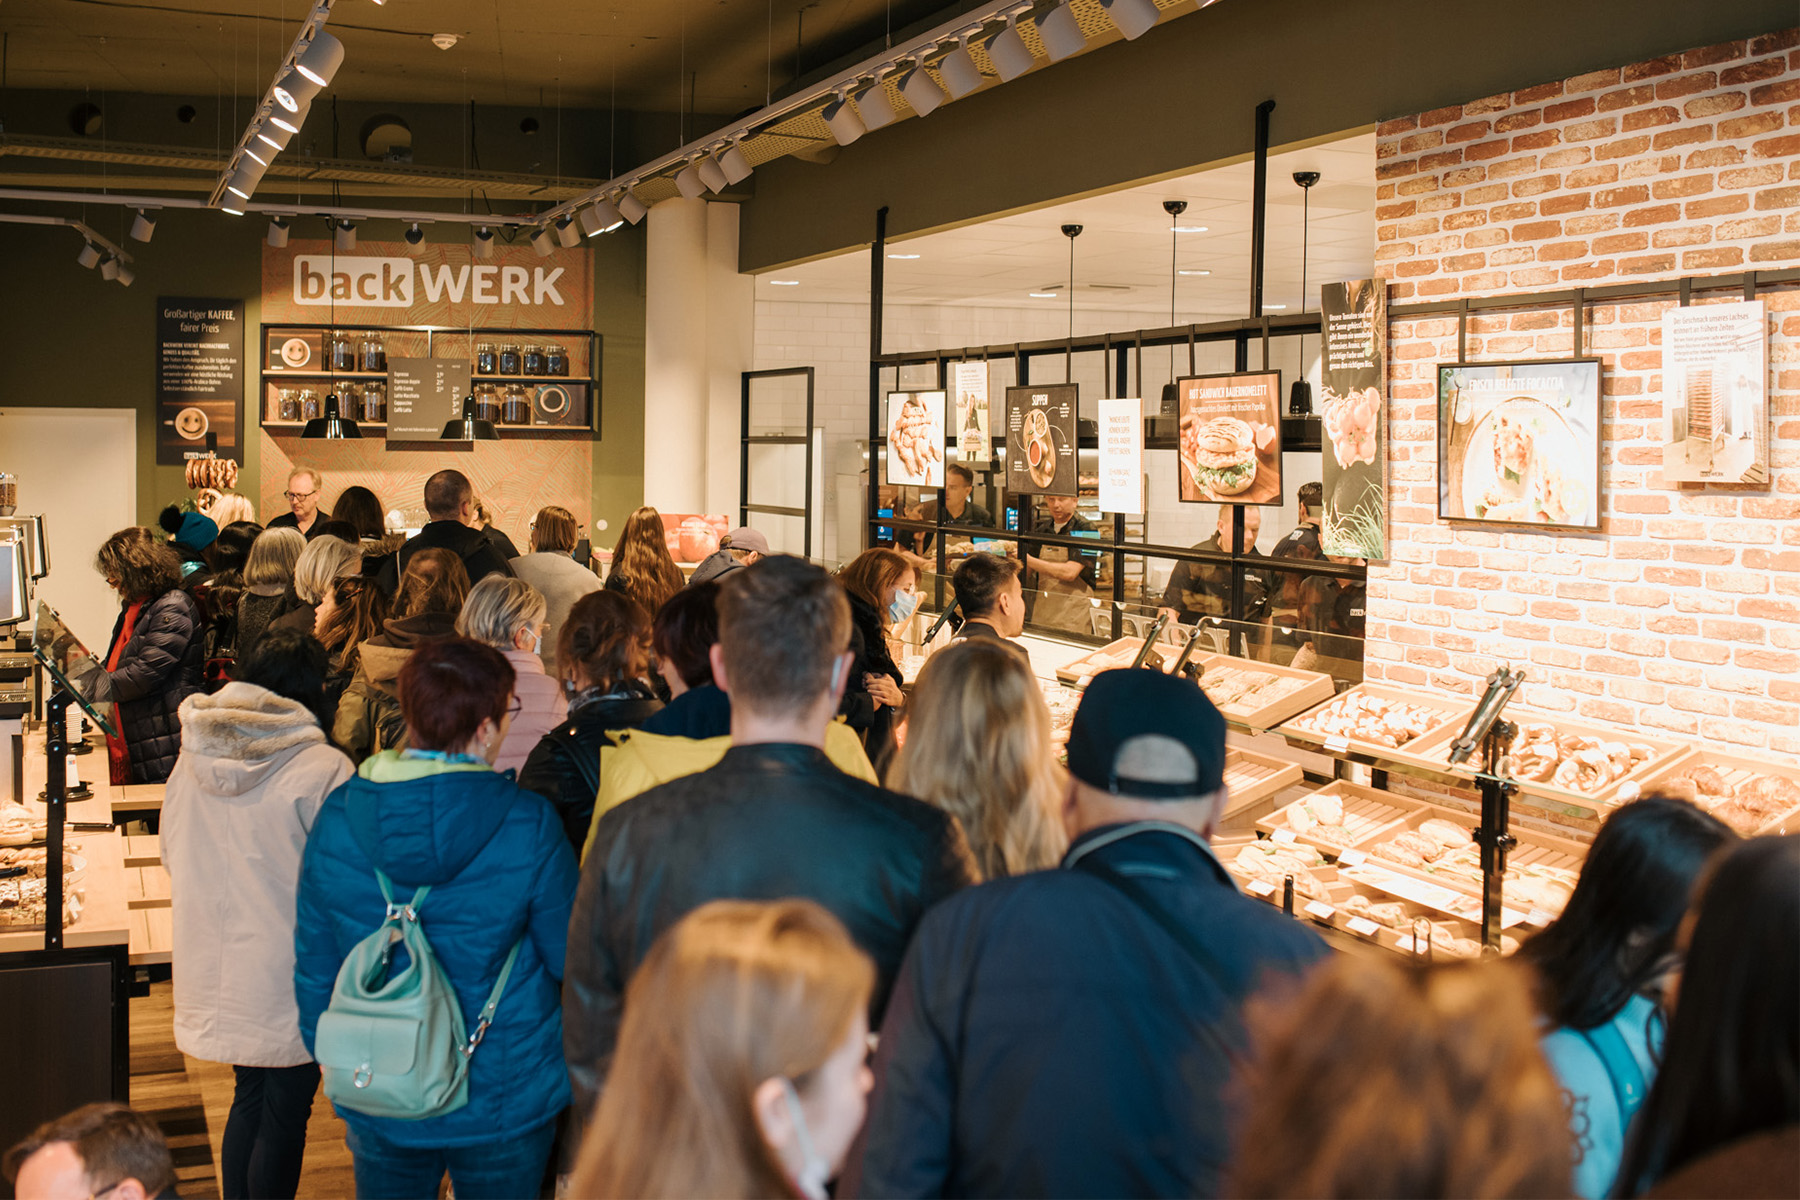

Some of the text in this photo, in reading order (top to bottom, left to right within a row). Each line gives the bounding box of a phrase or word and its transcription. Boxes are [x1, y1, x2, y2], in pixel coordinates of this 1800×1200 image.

[300, 260, 565, 305] back WERK
[164, 309, 236, 321] Großartiger KAFFEE,
[1342, 312, 1358, 320] Tomaten
[1682, 315, 1708, 325] Geschmack
[1709, 314, 1728, 323] unseres
[1729, 312, 1749, 321] Lachses
[180, 322, 220, 333] fairer Preis
[1673, 327, 1692, 335] erinnert
[1700, 324, 1718, 333] frühere
[1718, 324, 1735, 332] Zeiten
[1527, 376, 1564, 391] FOCACCIA
[1189, 384, 1267, 400] HOT SANDWICH BAUERNOMELETT
[1031, 394, 1048, 406] SUPPEN
